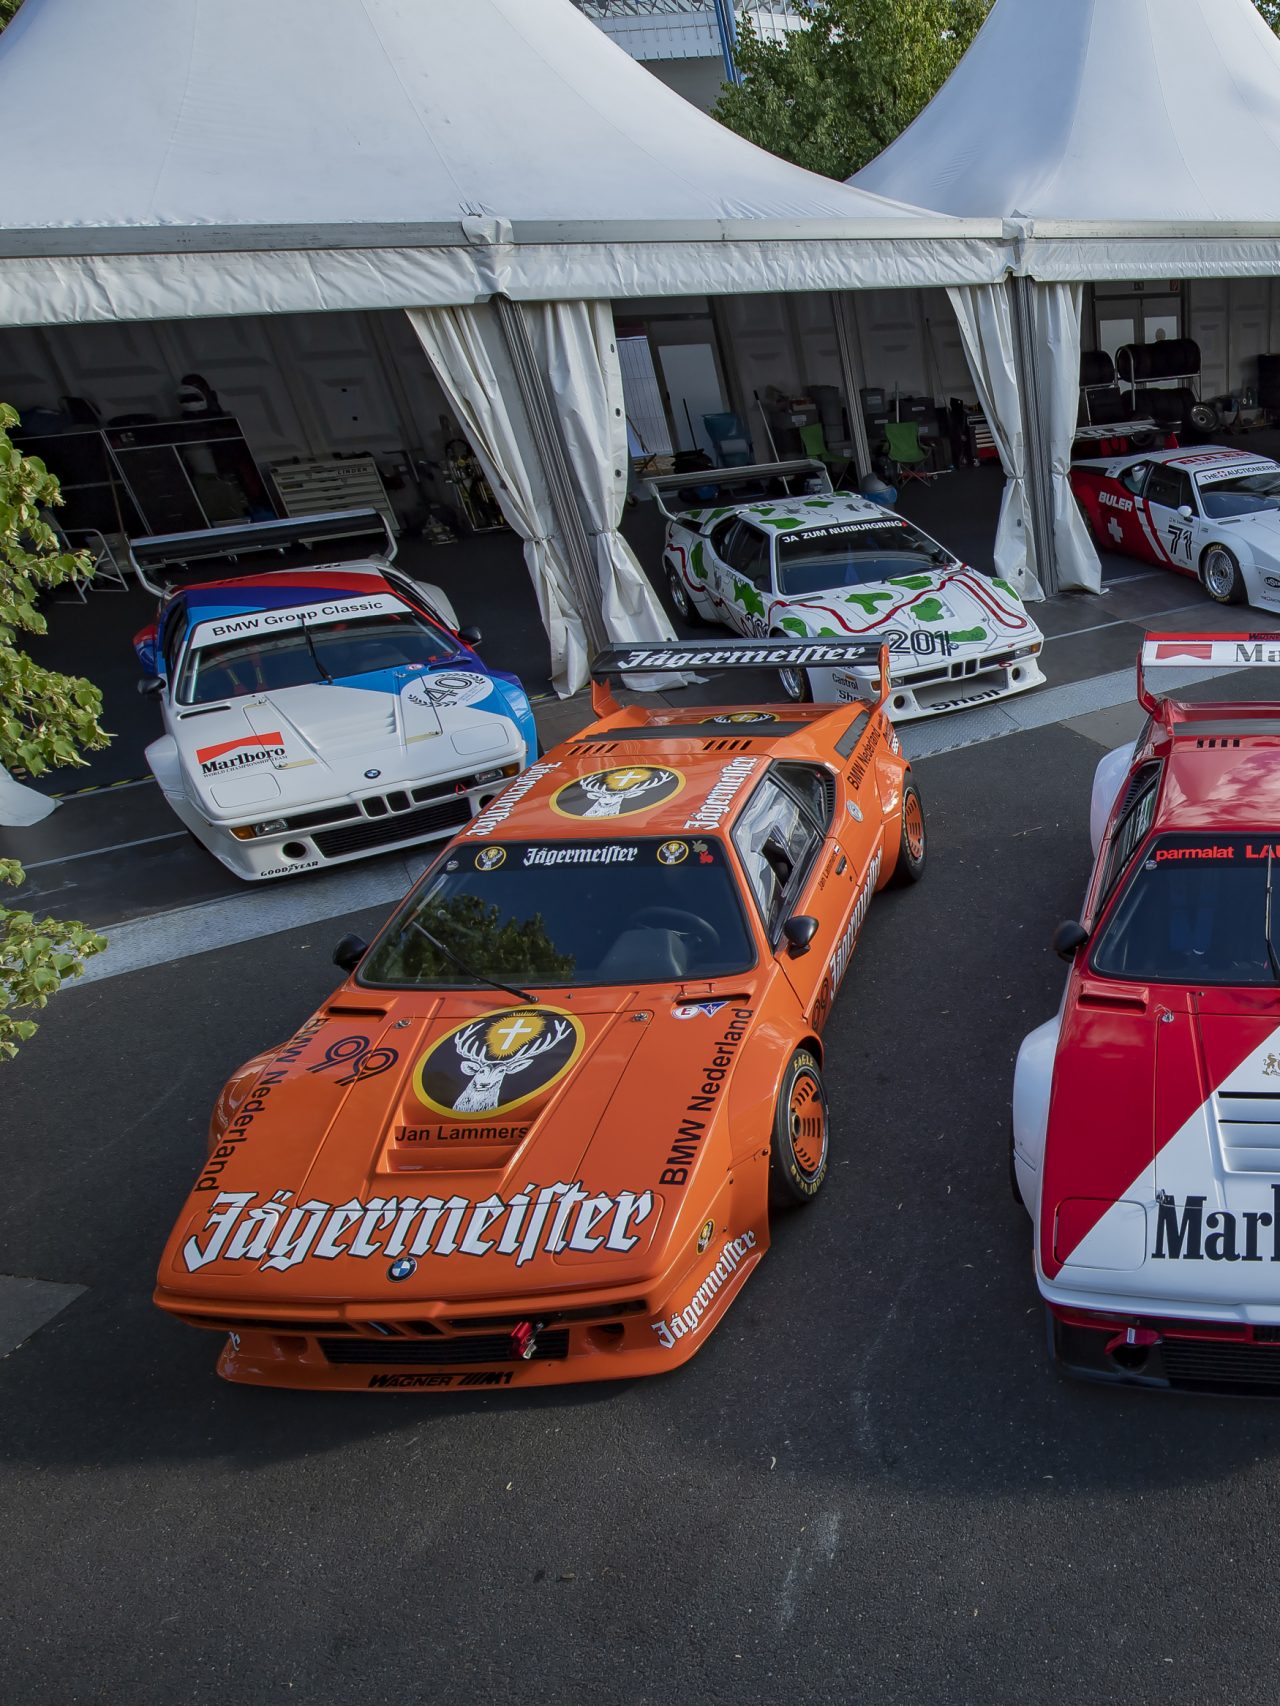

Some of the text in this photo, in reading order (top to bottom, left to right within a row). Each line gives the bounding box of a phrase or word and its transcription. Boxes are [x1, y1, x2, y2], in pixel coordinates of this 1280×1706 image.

[1202, 473, 1220, 481] THE
[1098, 491, 1133, 512] BULER
[782, 534, 799, 543] JA
[801, 530, 827, 540] ZUM
[1168, 524, 1192, 560] 71
[213, 601, 384, 636] BMW Group Classic
[886, 629, 951, 657] 201
[424, 677, 472, 702] 40
[832, 673, 859, 691] Castrol
[930, 689, 1000, 711] Shell
[201, 747, 286, 774] Marlboro
[847, 724, 881, 791] BMW Nederland
[1155, 846, 1235, 862] parmalat
[260, 861, 319, 876] GOODYEAR
[306, 1035, 399, 1087] 99
[793, 1054, 815, 1071] EAGLE
[193, 1018, 323, 1192] BMW Nederland
[658, 1008, 754, 1187] BMW Nederland
[395, 1123, 529, 1143] Jan Lammers
[368, 1374, 453, 1387] WAGNER
